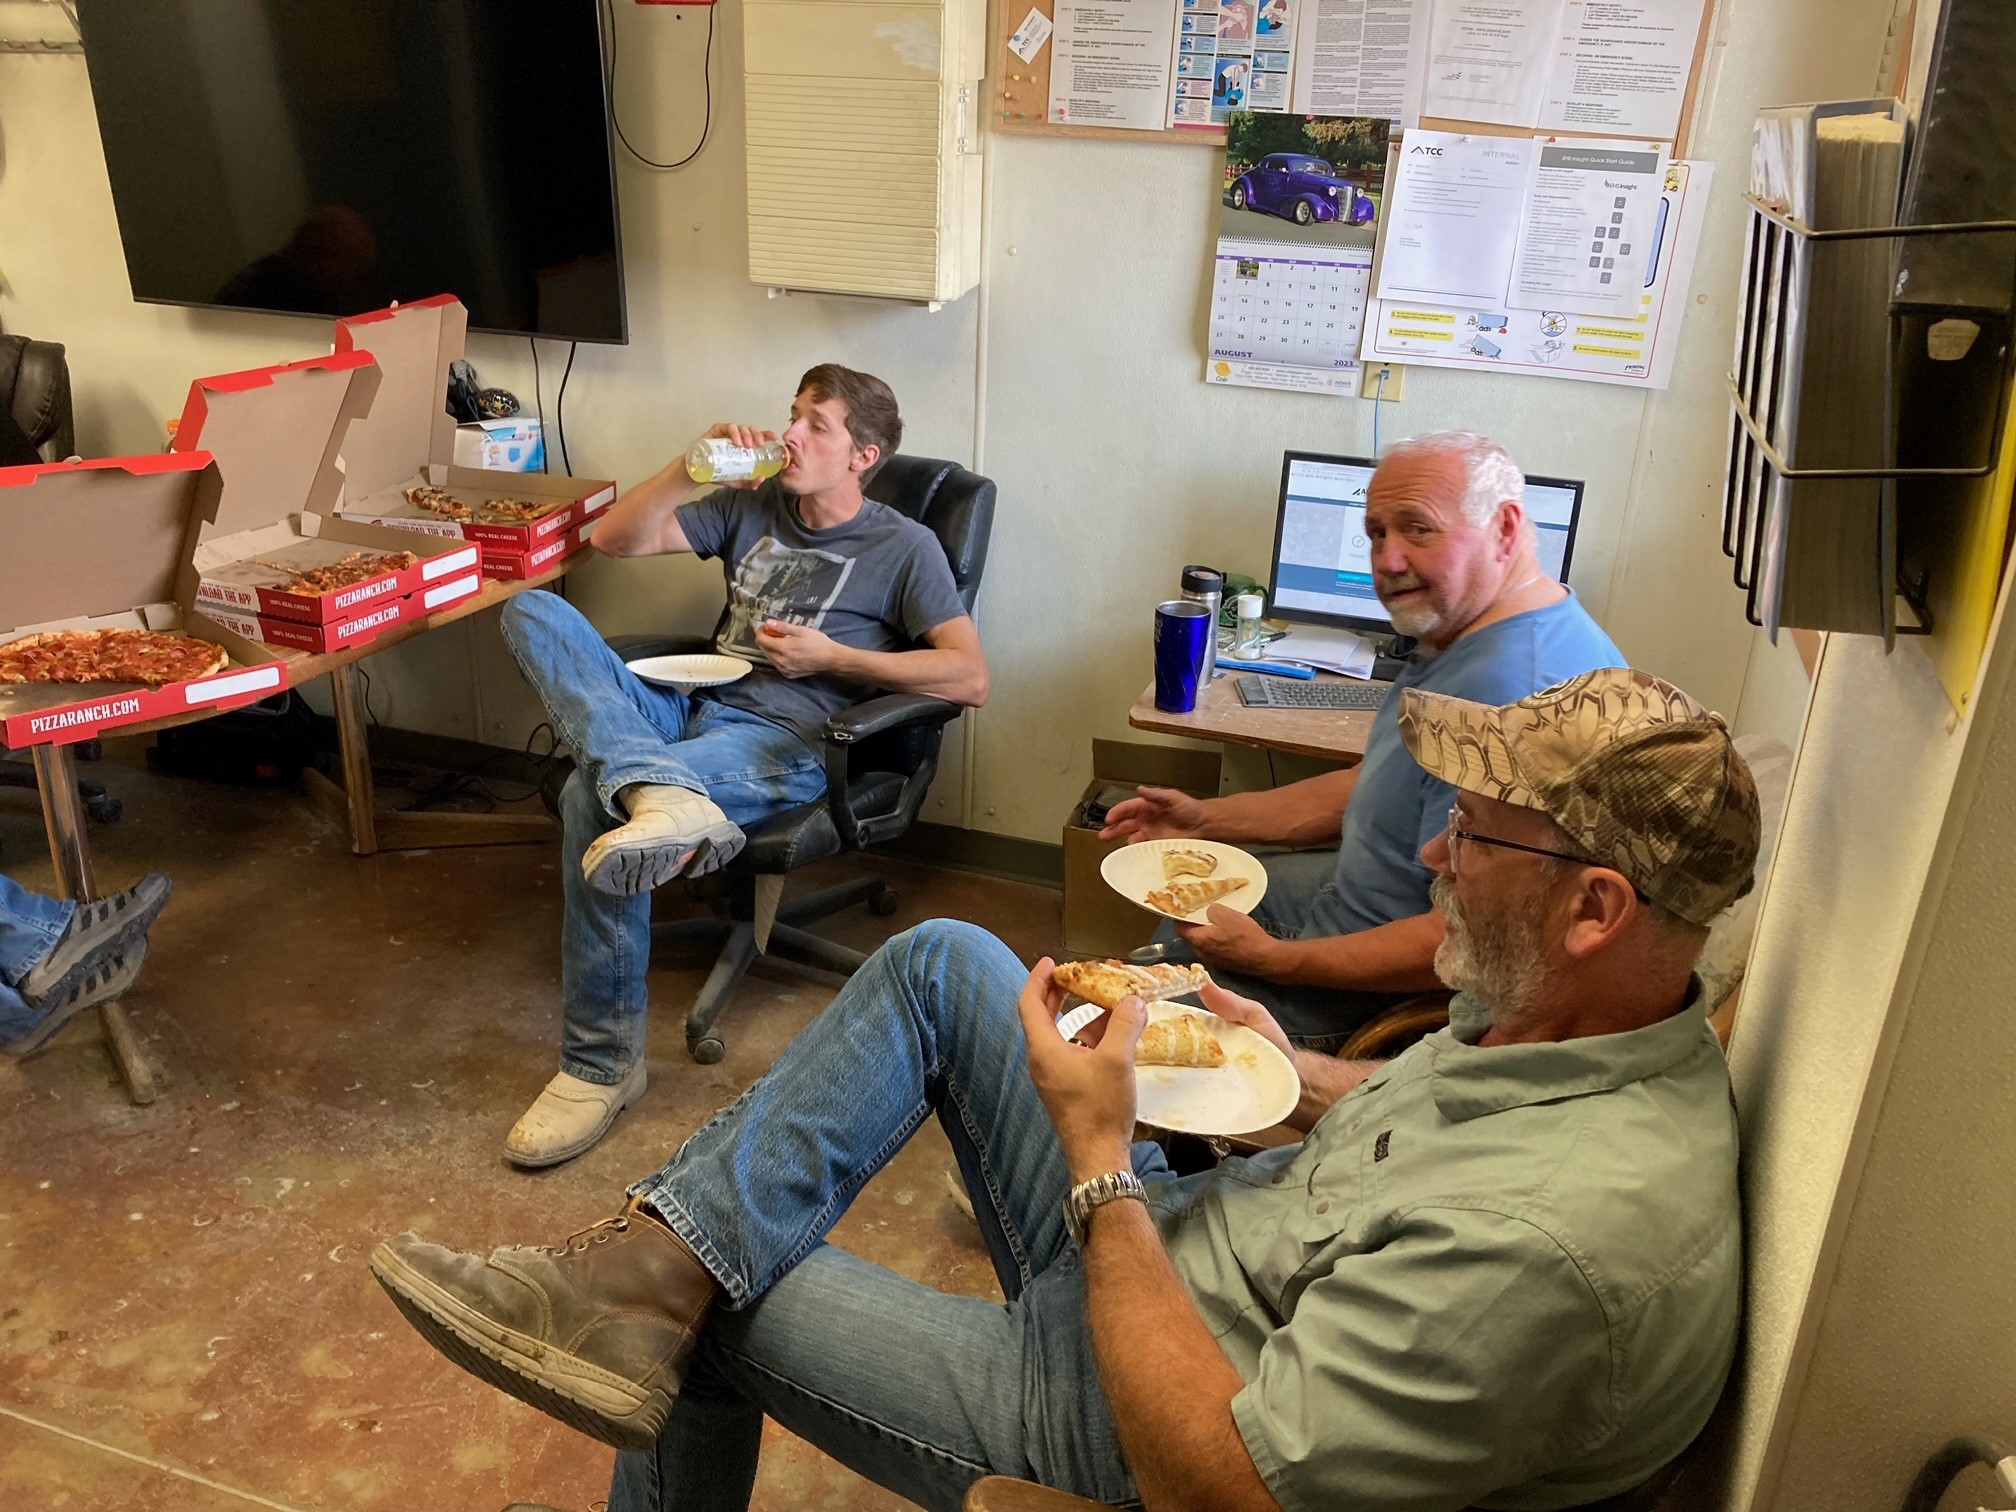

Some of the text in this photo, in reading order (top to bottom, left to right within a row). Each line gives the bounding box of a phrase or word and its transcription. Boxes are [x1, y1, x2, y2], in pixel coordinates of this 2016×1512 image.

[1482, 151, 1520, 160] INTERNAL
[1214, 349, 1253, 358] AUGUST
[224, 590, 238, 603] THE
[239, 593, 251, 605] APP
[335, 577, 397, 610] PIZZARANCH.COM
[294, 603, 310, 612] CHEESE
[338, 606, 400, 639] PIZZARANCH.COM
[242, 623, 254, 636] APP
[296, 634, 313, 642] CHEESE
[30, 698, 140, 734] PIZZARANCH.COM
